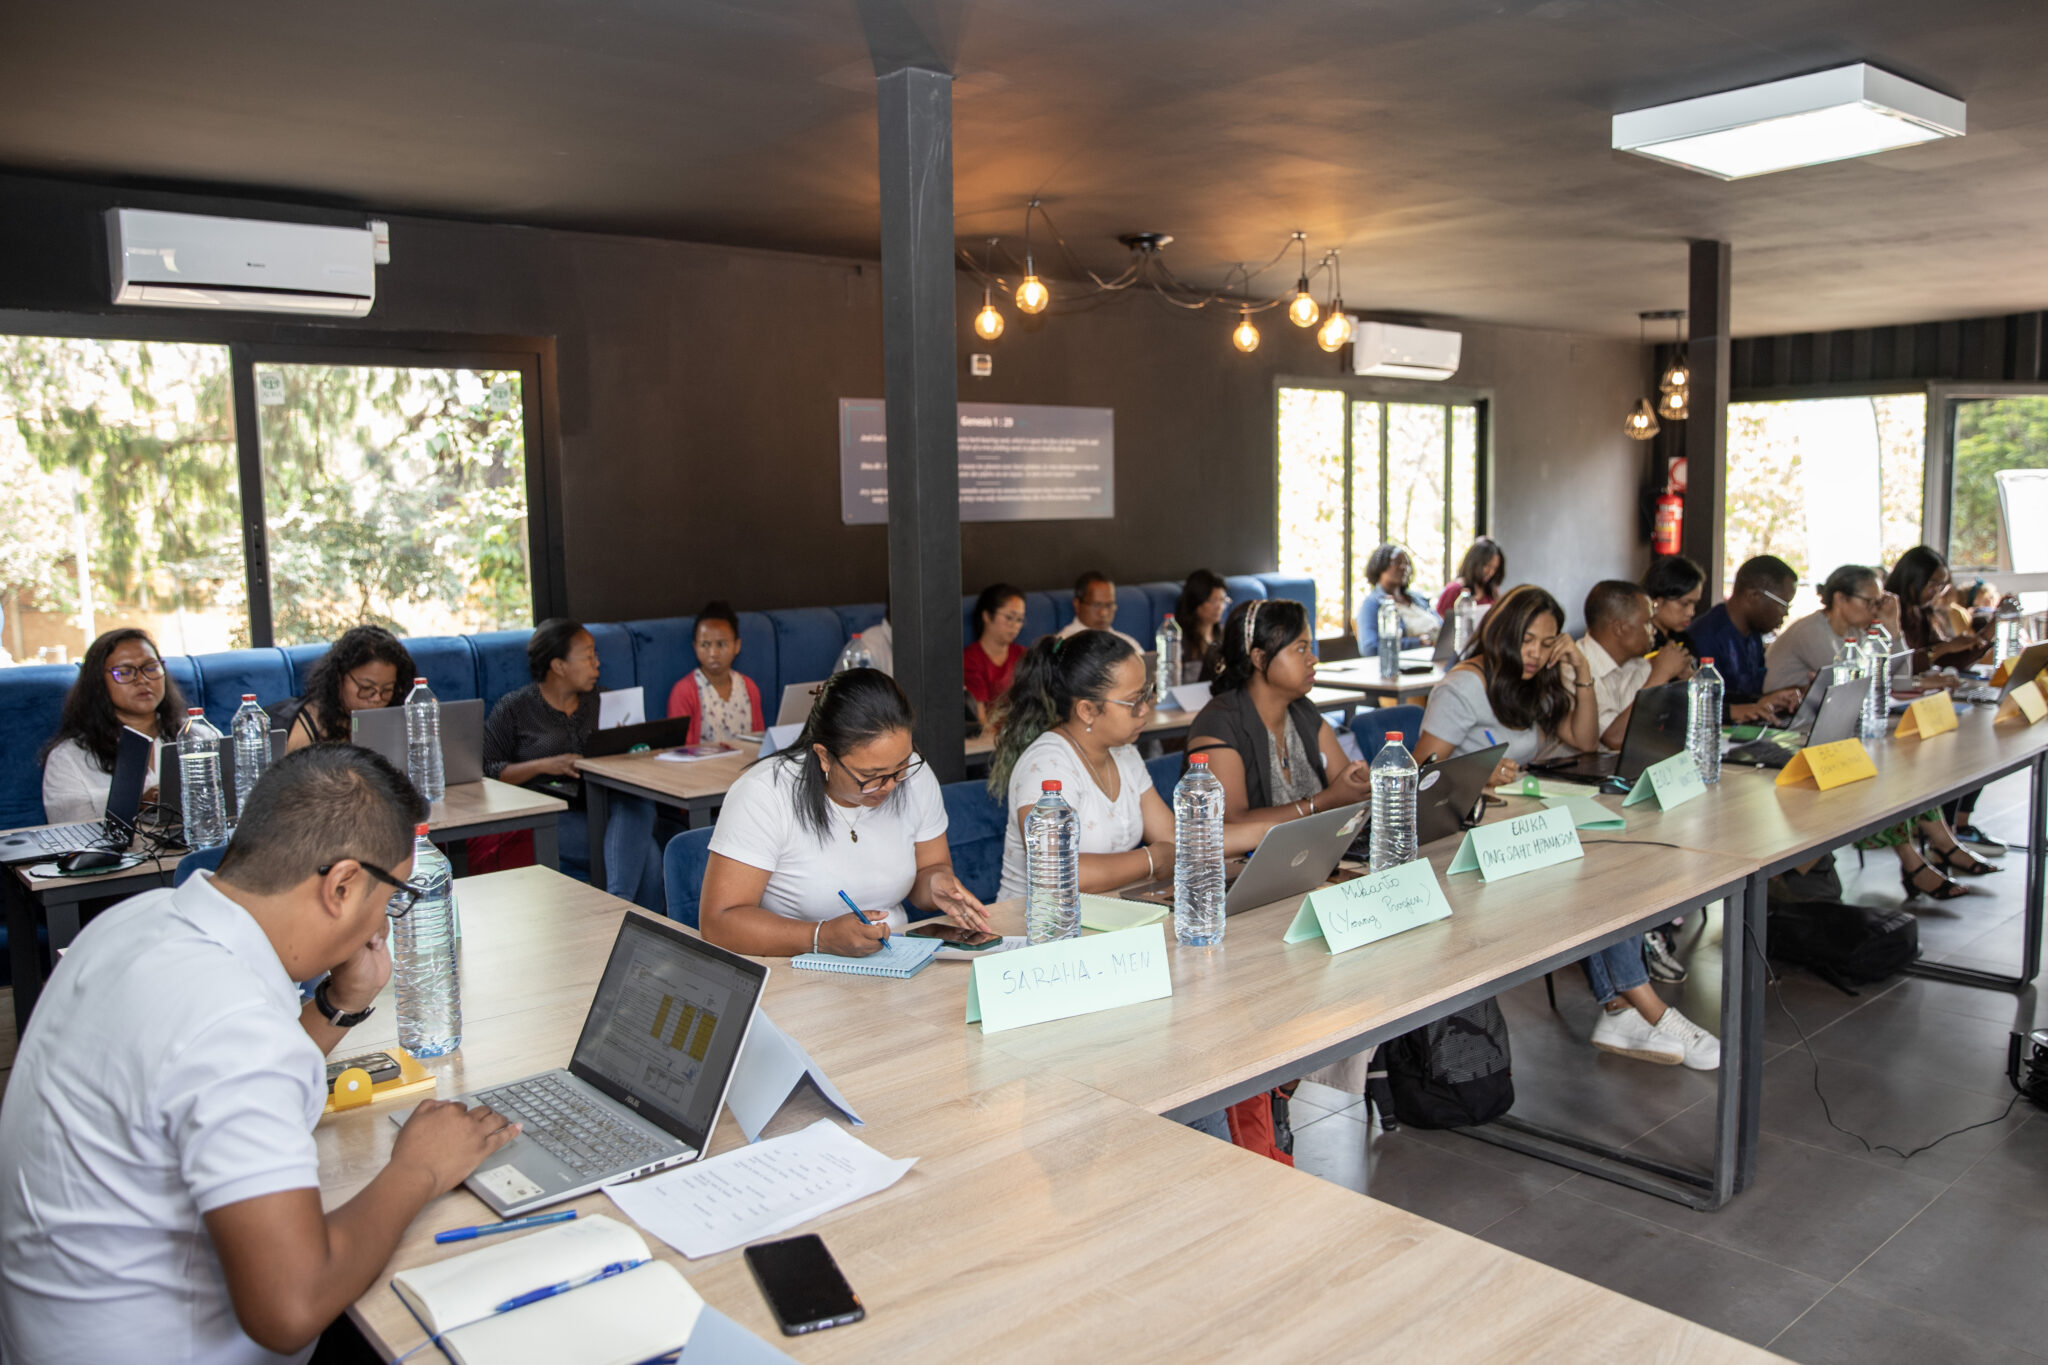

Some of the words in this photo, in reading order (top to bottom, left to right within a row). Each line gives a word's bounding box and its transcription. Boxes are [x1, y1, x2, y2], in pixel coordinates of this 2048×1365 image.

[1511, 815, 1548, 836] ERIKA
[1483, 849, 1505, 867] ONG
[1003, 959, 1091, 994] SARAHA
